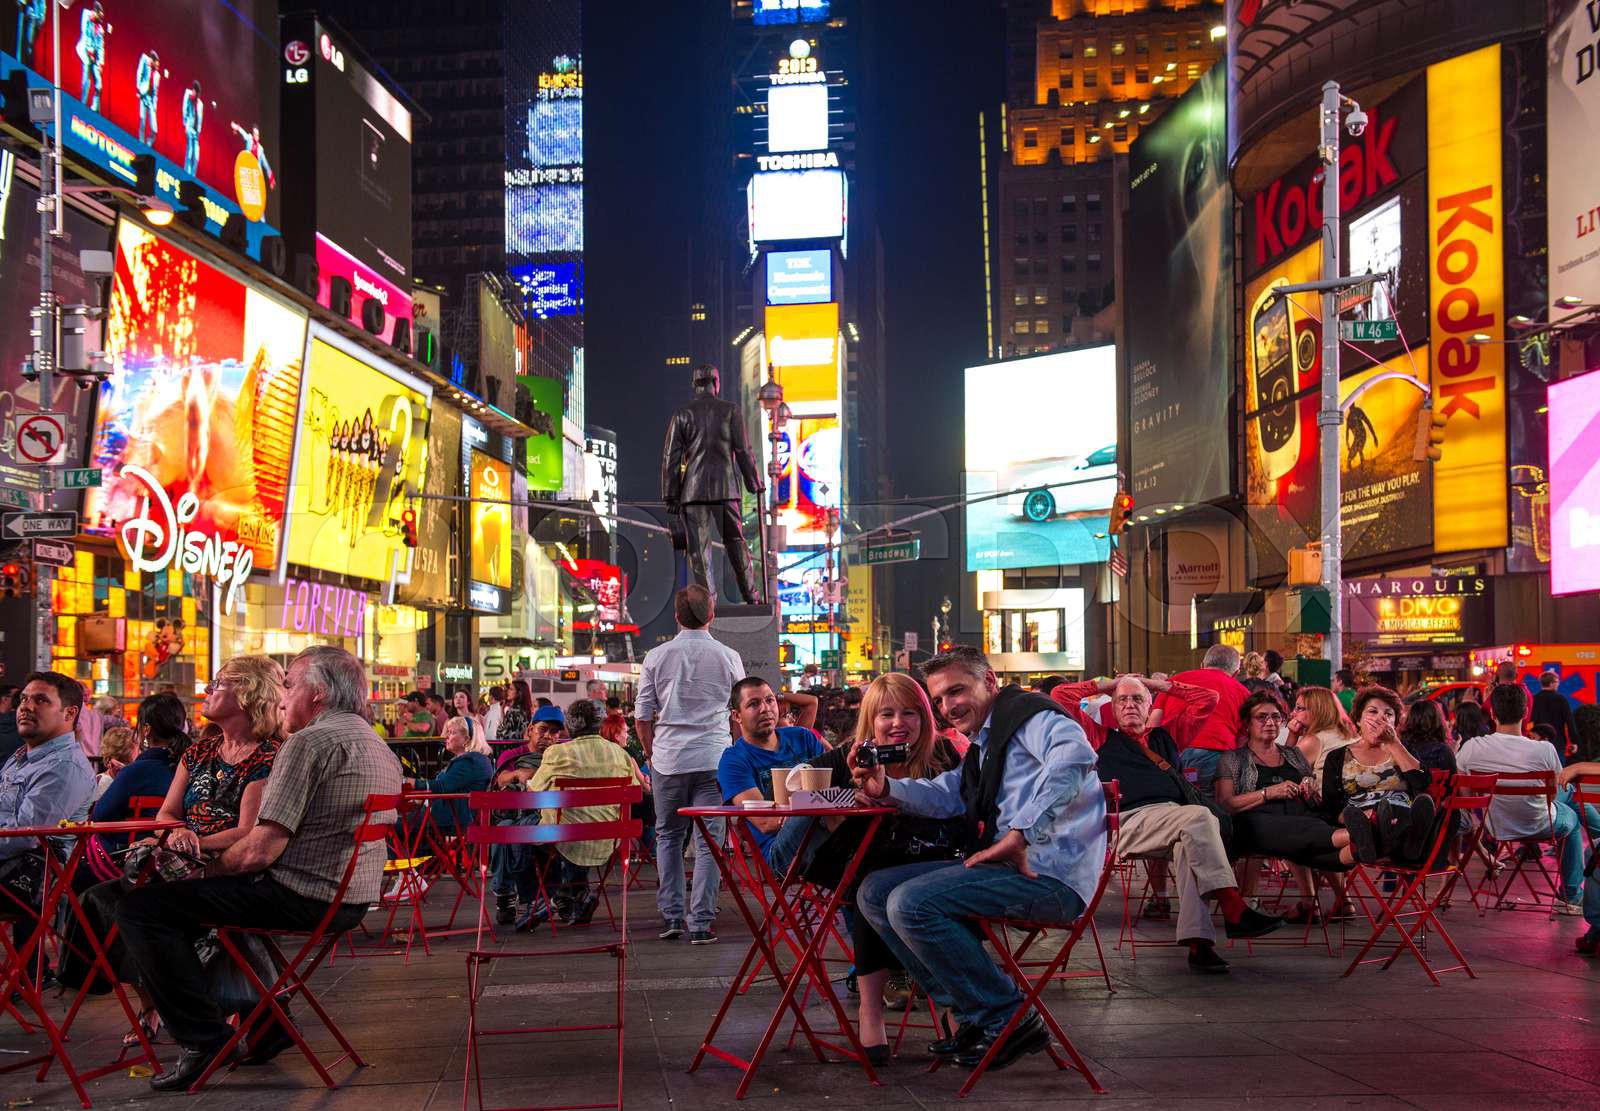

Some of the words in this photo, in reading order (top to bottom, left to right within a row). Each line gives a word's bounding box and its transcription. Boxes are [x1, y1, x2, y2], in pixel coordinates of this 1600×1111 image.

[778, 58, 817, 74] 2013
[286, 69, 308, 83] LG
[769, 71, 826, 85] TOSHIBA
[757, 152, 839, 171] TOSHIBA
[1437, 185, 1496, 420] Kodak
[1357, 322, 1365, 338] W
[1368, 322, 1382, 338] 46
[1386, 322, 1394, 331] ST
[1134, 403, 1180, 434] GRAVITY
[66, 471, 76, 486] W
[78, 471, 89, 486] 46
[1345, 490, 1357, 503] FOR
[1358, 486, 1371, 499] THE
[1371, 481, 1386, 497] WAY
[1387, 475, 1402, 491] YOU
[22, 520, 42, 531] ONE
[48, 519, 70, 530] WAY
[39, 545, 52, 557] ONE
[57, 548, 70, 560] WAY
[868, 548, 911, 561] Broadway
[1175, 563, 1219, 575] Marriott
[1348, 579, 1485, 595] MARQUIS
[281, 577, 368, 638] FOREVER
[1400, 597, 1460, 616] DIVO
[1427, 618, 1455, 629] AFFAIR
